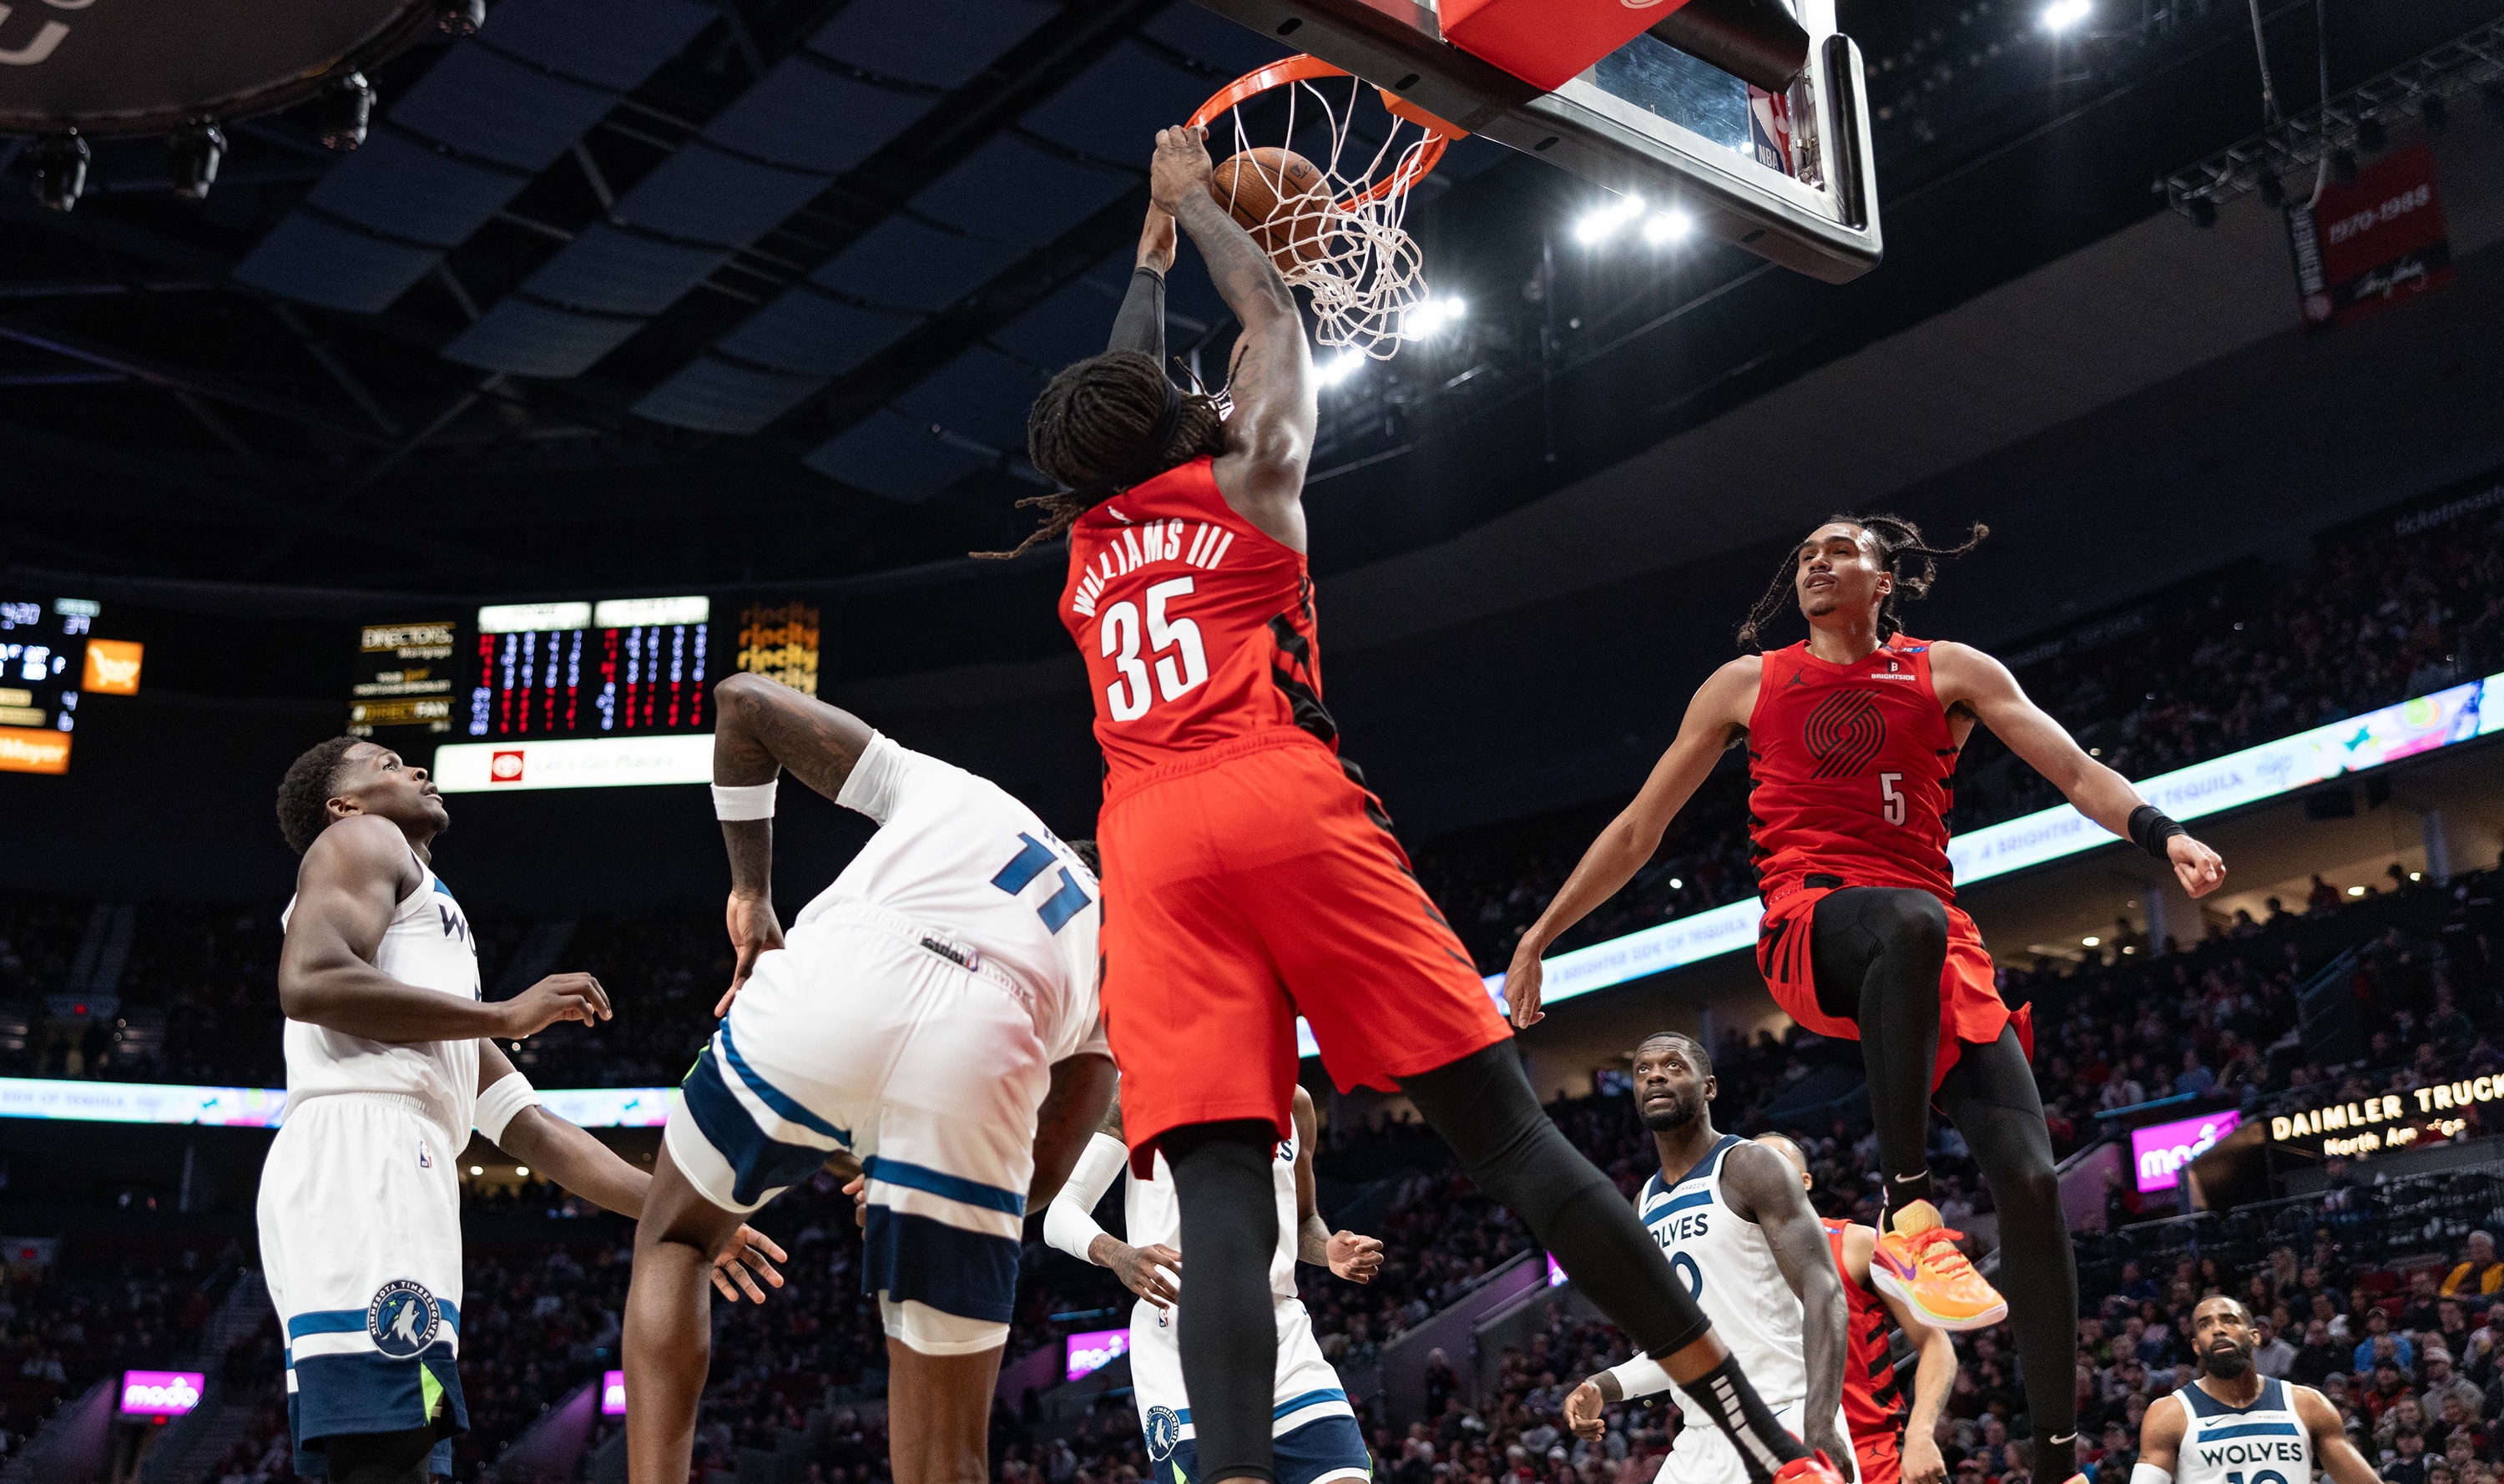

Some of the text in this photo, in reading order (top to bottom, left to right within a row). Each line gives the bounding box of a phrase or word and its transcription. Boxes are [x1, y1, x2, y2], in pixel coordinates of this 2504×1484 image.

[1758, 143, 1780, 171] NBA
[1073, 518, 1234, 618] WILLIAMS III
[1100, 575, 1209, 722] 35
[1870, 673, 1916, 681] BRIGHTSIDE
[1891, 662, 1899, 673] B
[1880, 772, 1906, 827] 5
[2163, 771, 2246, 807] TEQUILA
[990, 831, 1093, 936] 11
[2271, 1094, 2405, 1141] DAIMLER
[2324, 1131, 2380, 1156] North
[1652, 1213, 1709, 1249] LVES
[370, 1281, 438, 1340] MINNESOTA TIMBERWOLVES
[124, 1376, 199, 1409] modo
[2199, 1442, 2302, 1467] WOLVES
